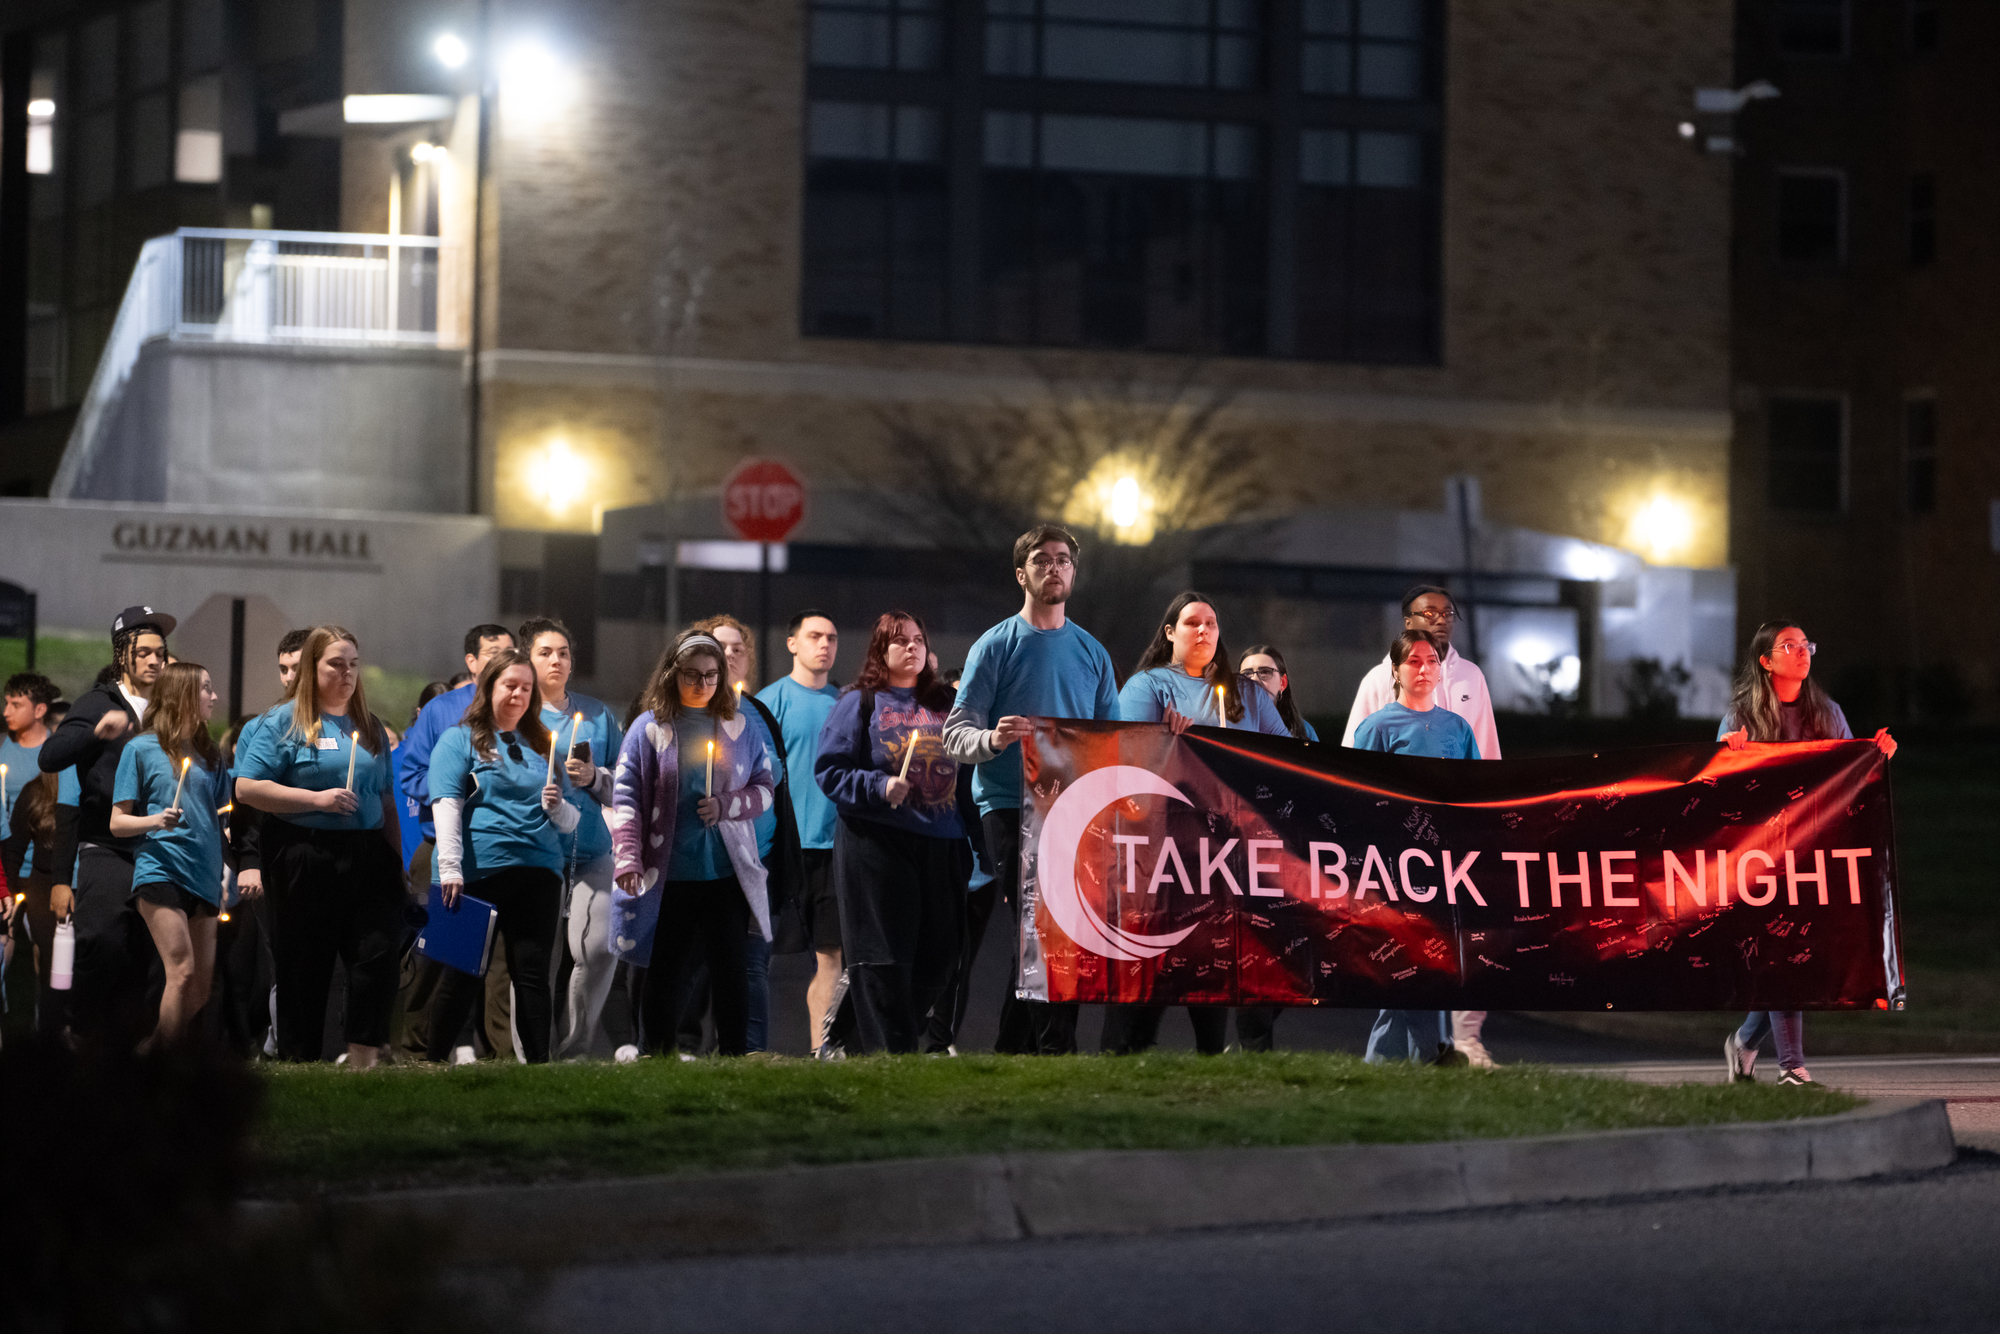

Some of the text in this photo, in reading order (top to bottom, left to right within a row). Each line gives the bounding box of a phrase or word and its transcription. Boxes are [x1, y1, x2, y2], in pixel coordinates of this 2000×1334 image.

[729, 484, 800, 519] STOP
[112, 521, 371, 558] GUZMAN HALL
[1112, 834, 1285, 898] TAKE
[1309, 840, 1488, 908] BACK
[1501, 850, 1641, 909] THE
[1663, 847, 1873, 908] NIGHT
